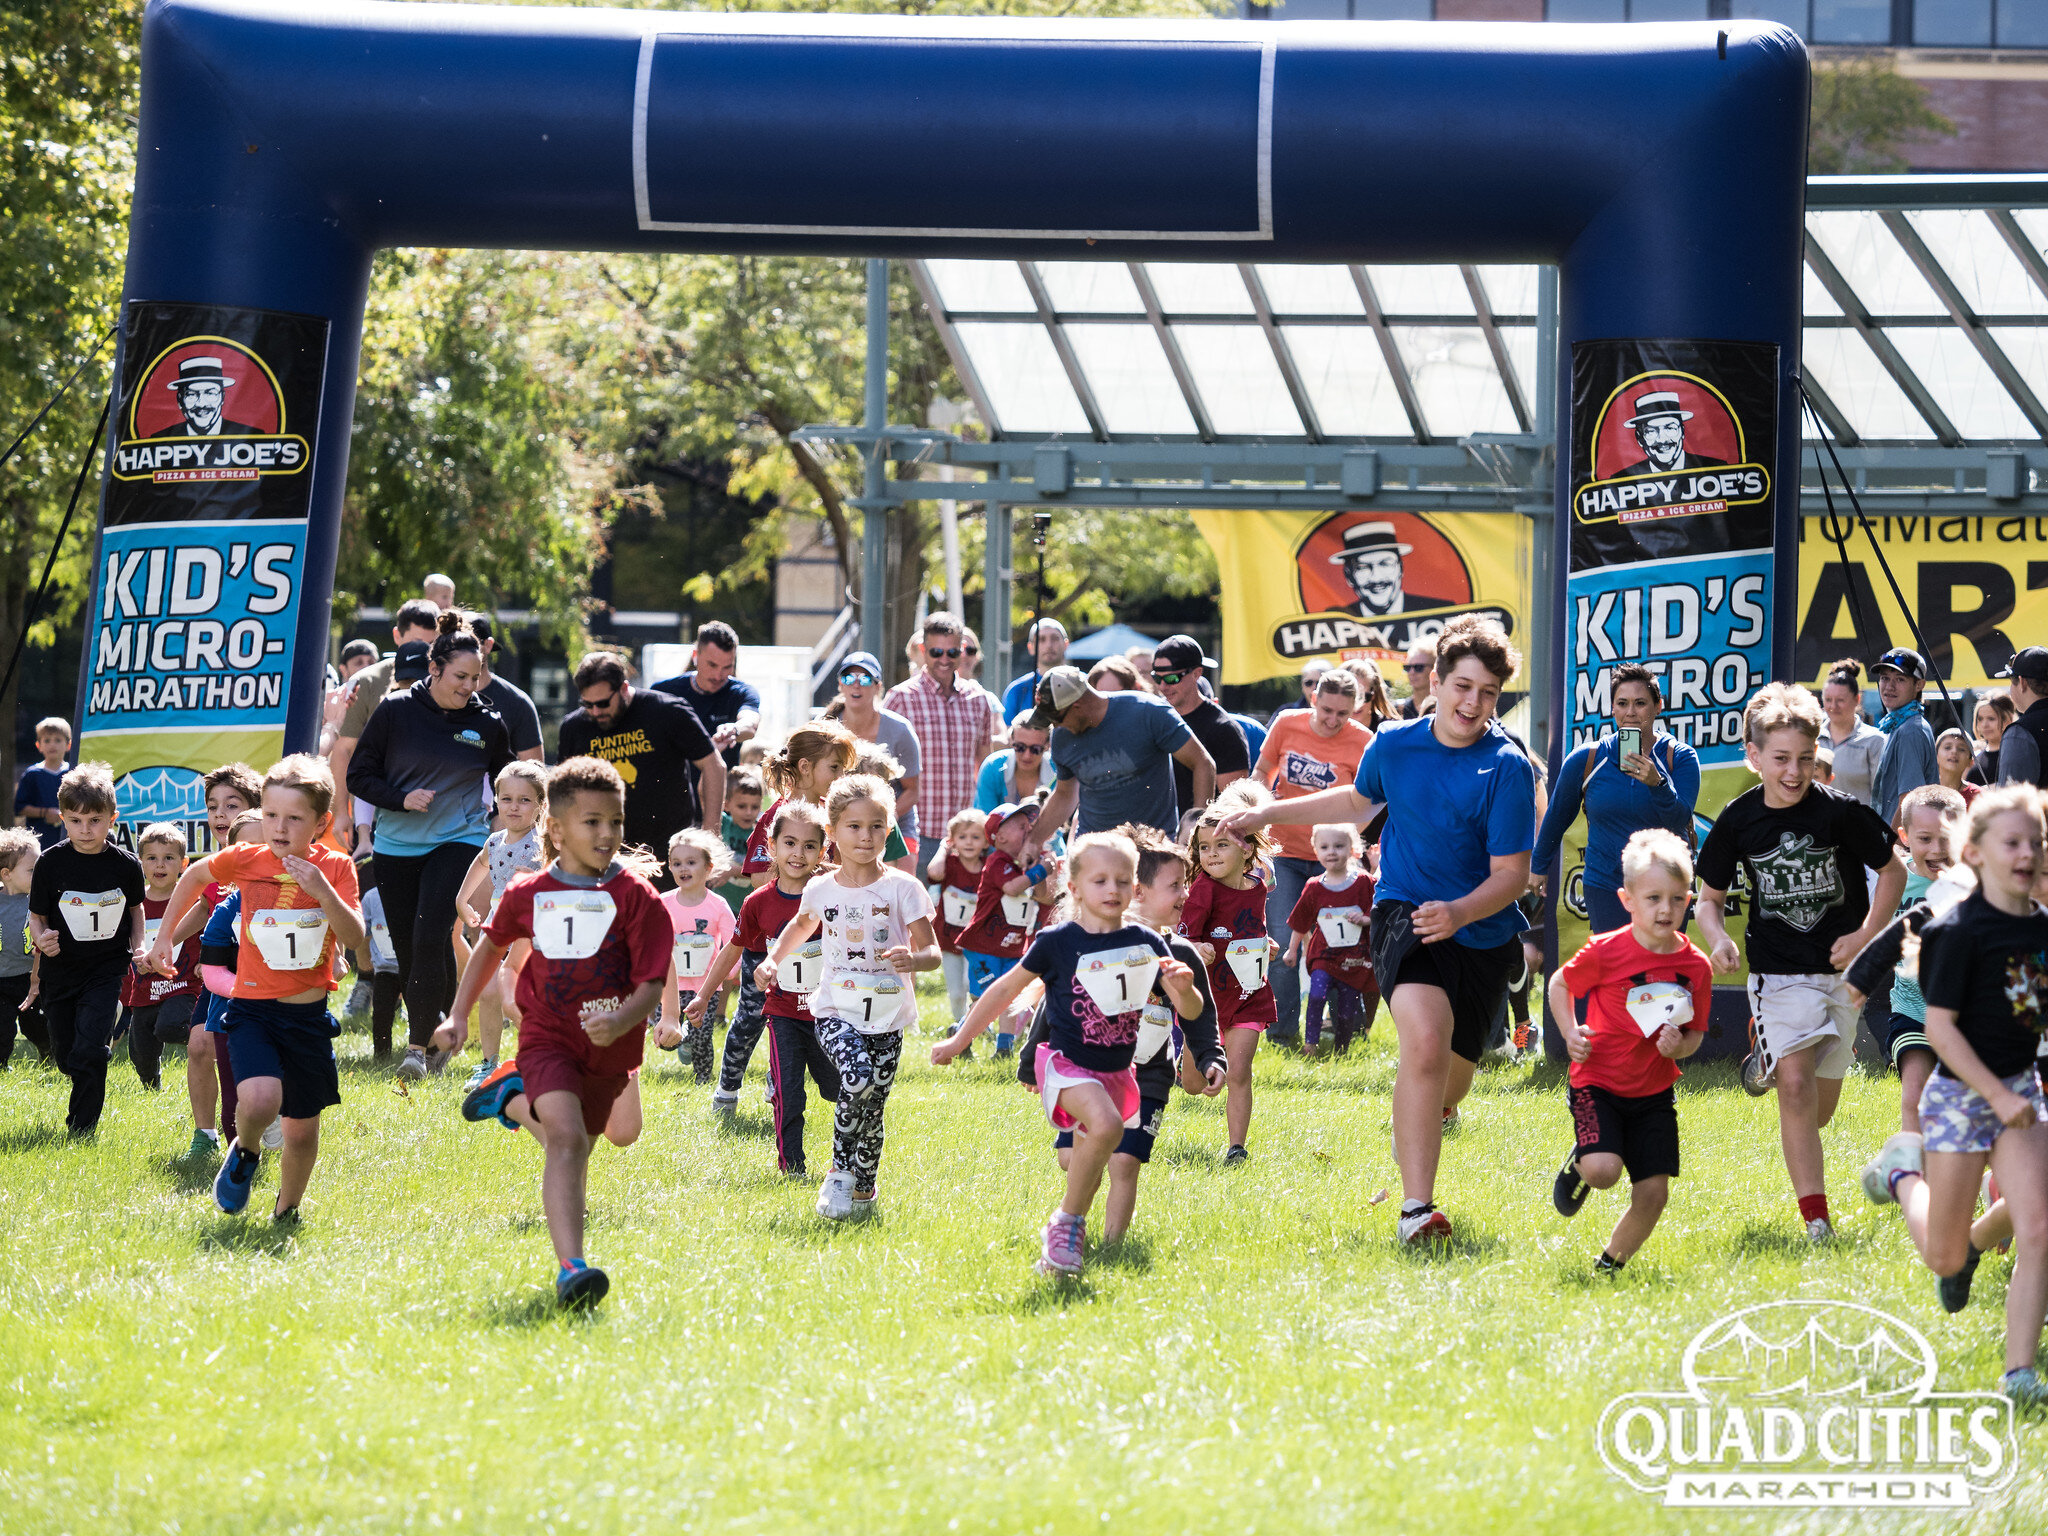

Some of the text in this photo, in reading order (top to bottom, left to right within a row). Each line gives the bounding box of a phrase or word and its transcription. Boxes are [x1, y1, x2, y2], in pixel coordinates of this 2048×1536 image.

[118, 442, 300, 471] HAPPY JOE'S
[157, 470, 255, 480] PIZZA & ICE CREAM
[1581, 472, 1763, 515] HAPPY JOE'S
[1622, 502, 1724, 521] PIZZA & ICE CREAM
[102, 544, 296, 620] KID'S
[1576, 575, 1765, 666] KID'S
[96, 618, 284, 675] MICRO-
[1281, 621, 1395, 654] HAPPY
[90, 674, 283, 715] MARATHON
[1574, 652, 1764, 722] MRO-
[590, 729, 645, 751] PUNTING
[89, 911, 98, 931] 1
[960, 905, 966, 920] 1
[1022, 902, 1028, 919] 1
[563, 916, 573, 945] 1
[1337, 922, 1344, 939] 1
[285, 932, 296, 959] 1
[683, 951, 691, 969] 1
[792, 961, 802, 983] 1
[1255, 957, 1263, 979] 1
[1115, 973, 1127, 1001] 1
[582, 996, 619, 1010] MICRO
[862, 997, 872, 1022] 1
